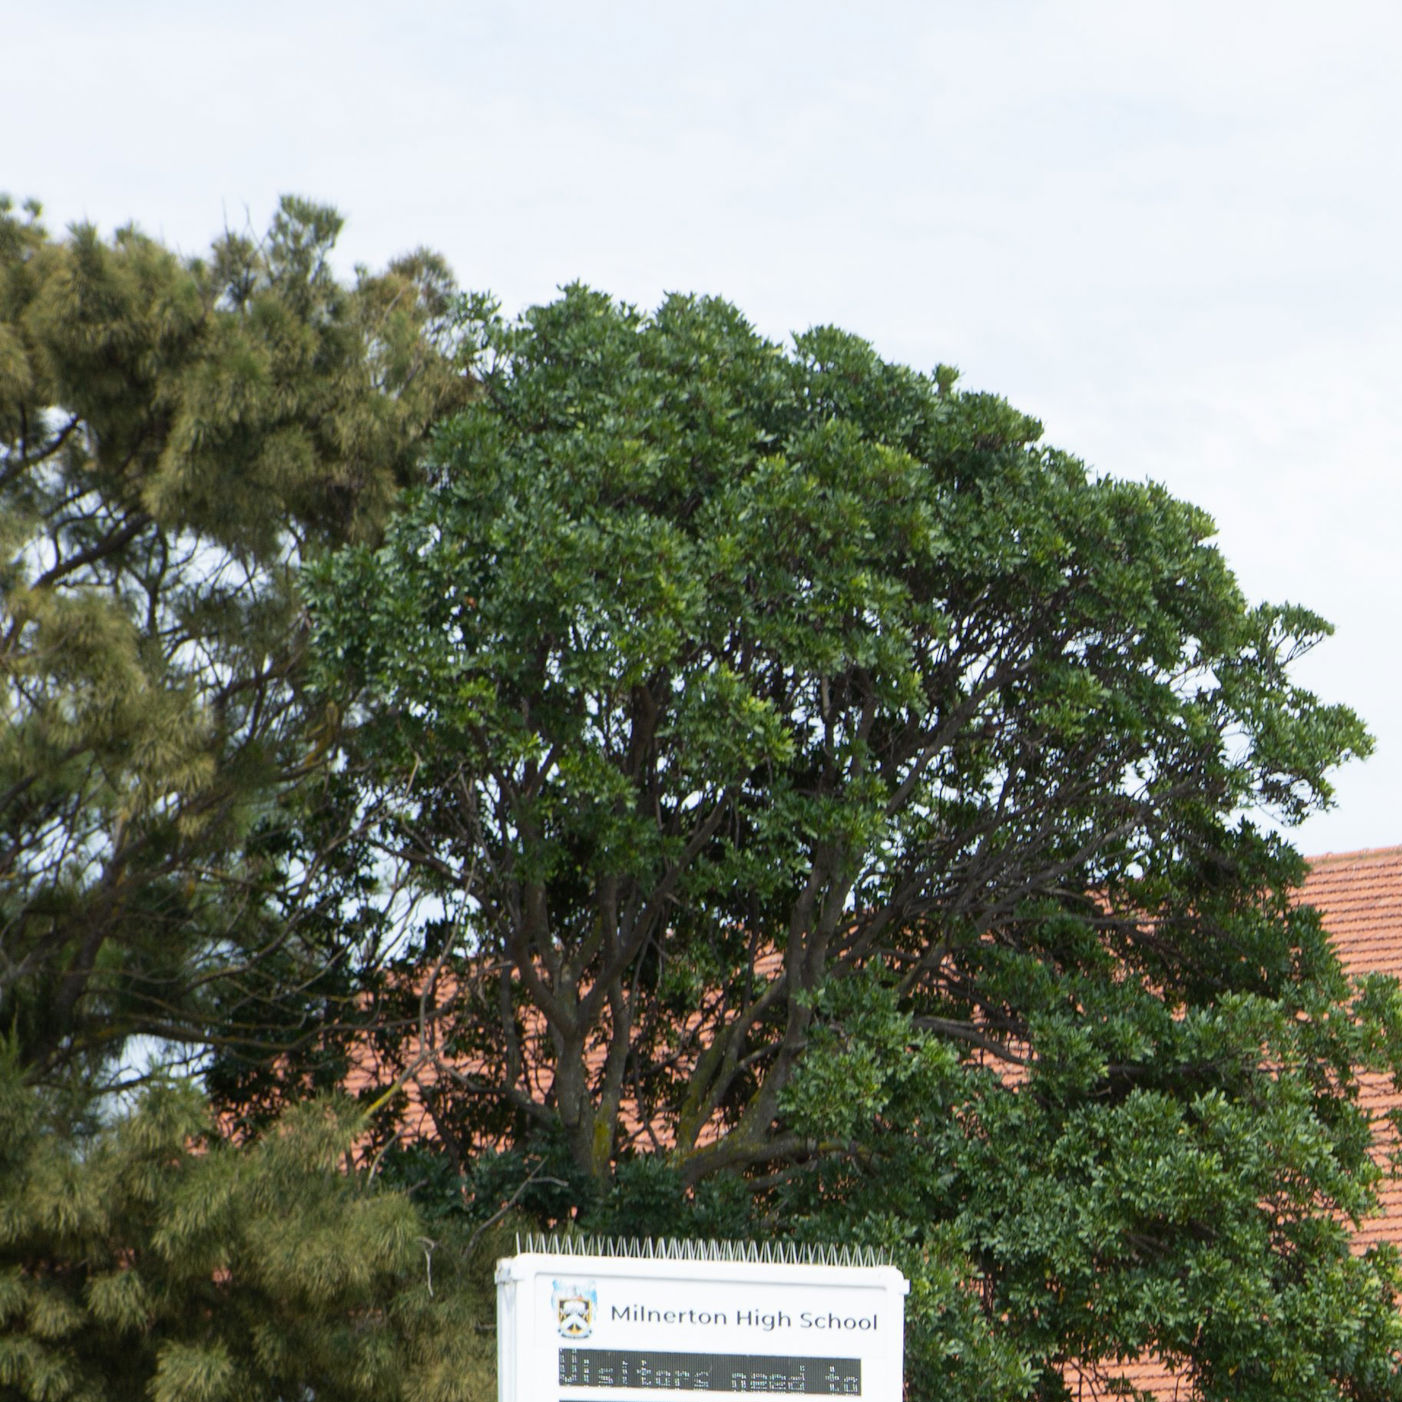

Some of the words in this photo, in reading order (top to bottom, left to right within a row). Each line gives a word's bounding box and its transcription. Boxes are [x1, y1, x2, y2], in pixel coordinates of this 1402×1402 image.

[610, 1304, 728, 1326] Milnerton
[736, 1308, 792, 1332] High
[799, 1311, 879, 1332] School
[558, 1347, 711, 1389] Visitors
[731, 1364, 806, 1393] need
[824, 1365, 860, 1394] to
